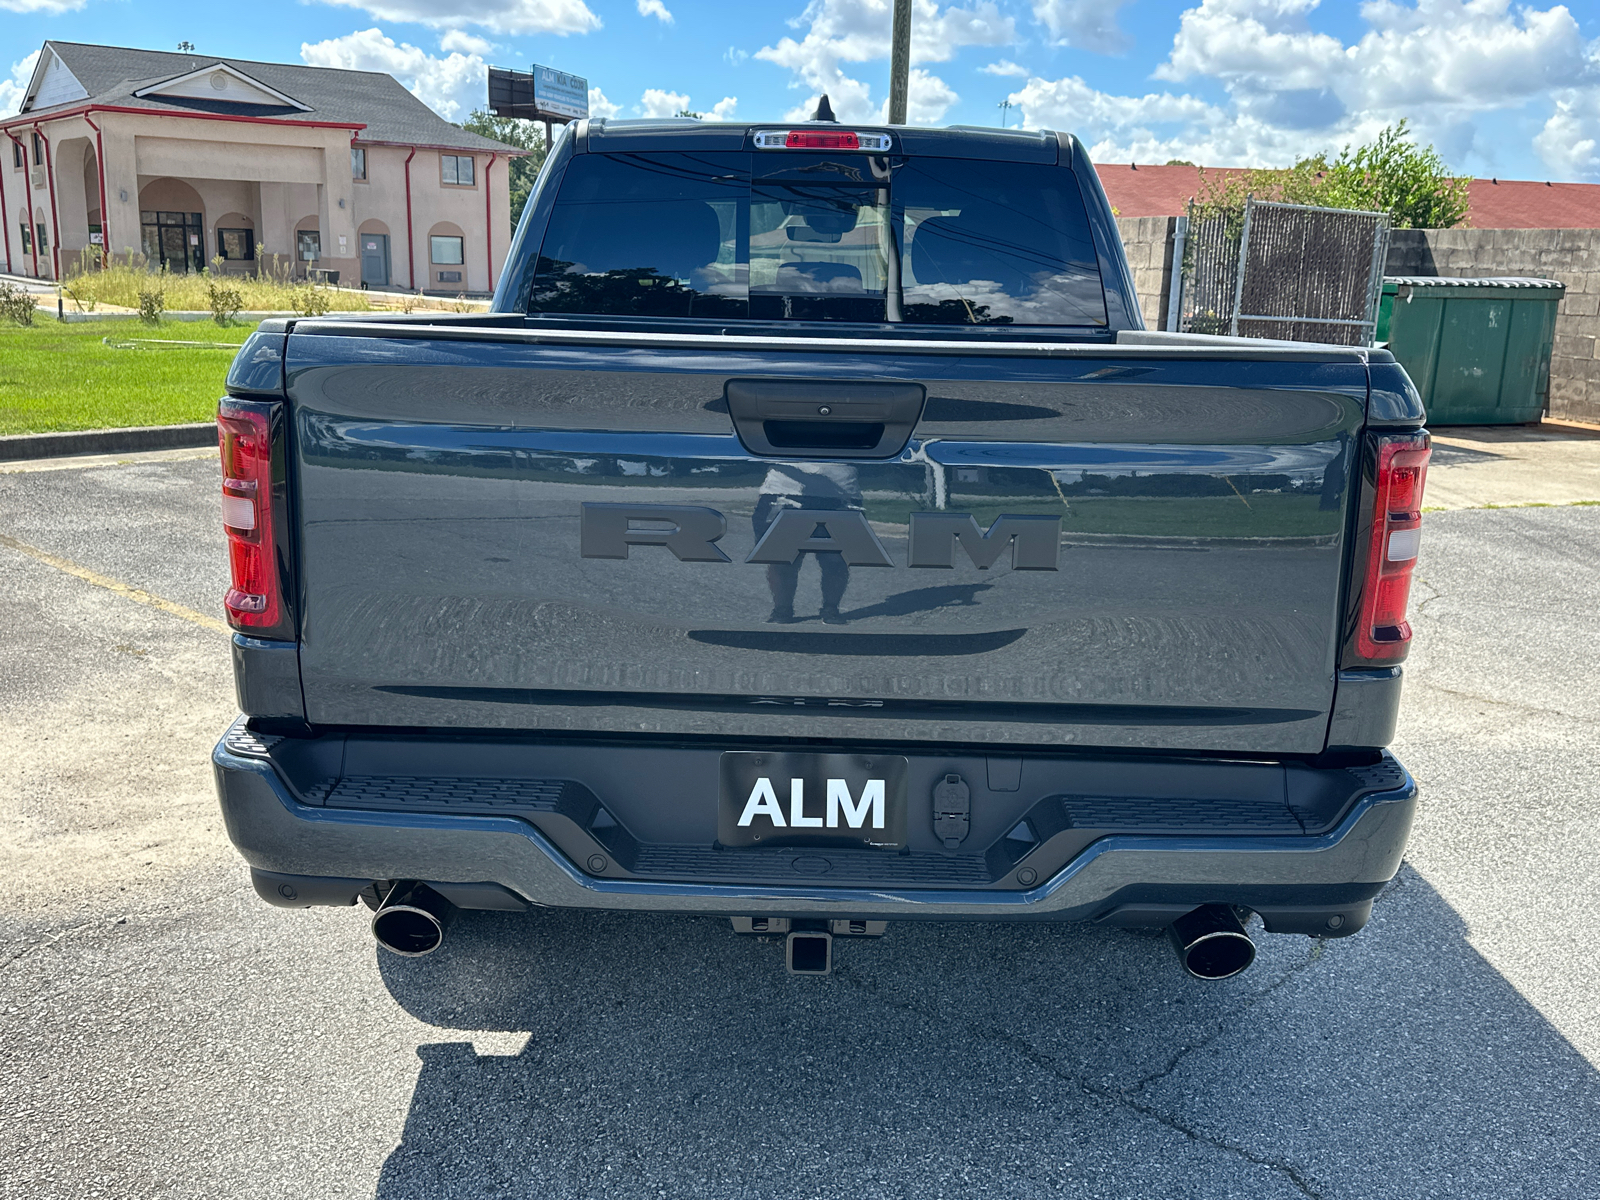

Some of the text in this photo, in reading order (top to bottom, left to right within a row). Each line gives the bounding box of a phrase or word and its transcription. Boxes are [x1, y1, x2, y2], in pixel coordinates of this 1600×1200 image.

[541, 70, 555, 83] ALM
[557, 75, 567, 87] KIA
[580, 502, 1062, 571] RAM
[737, 777, 886, 829] ALM
